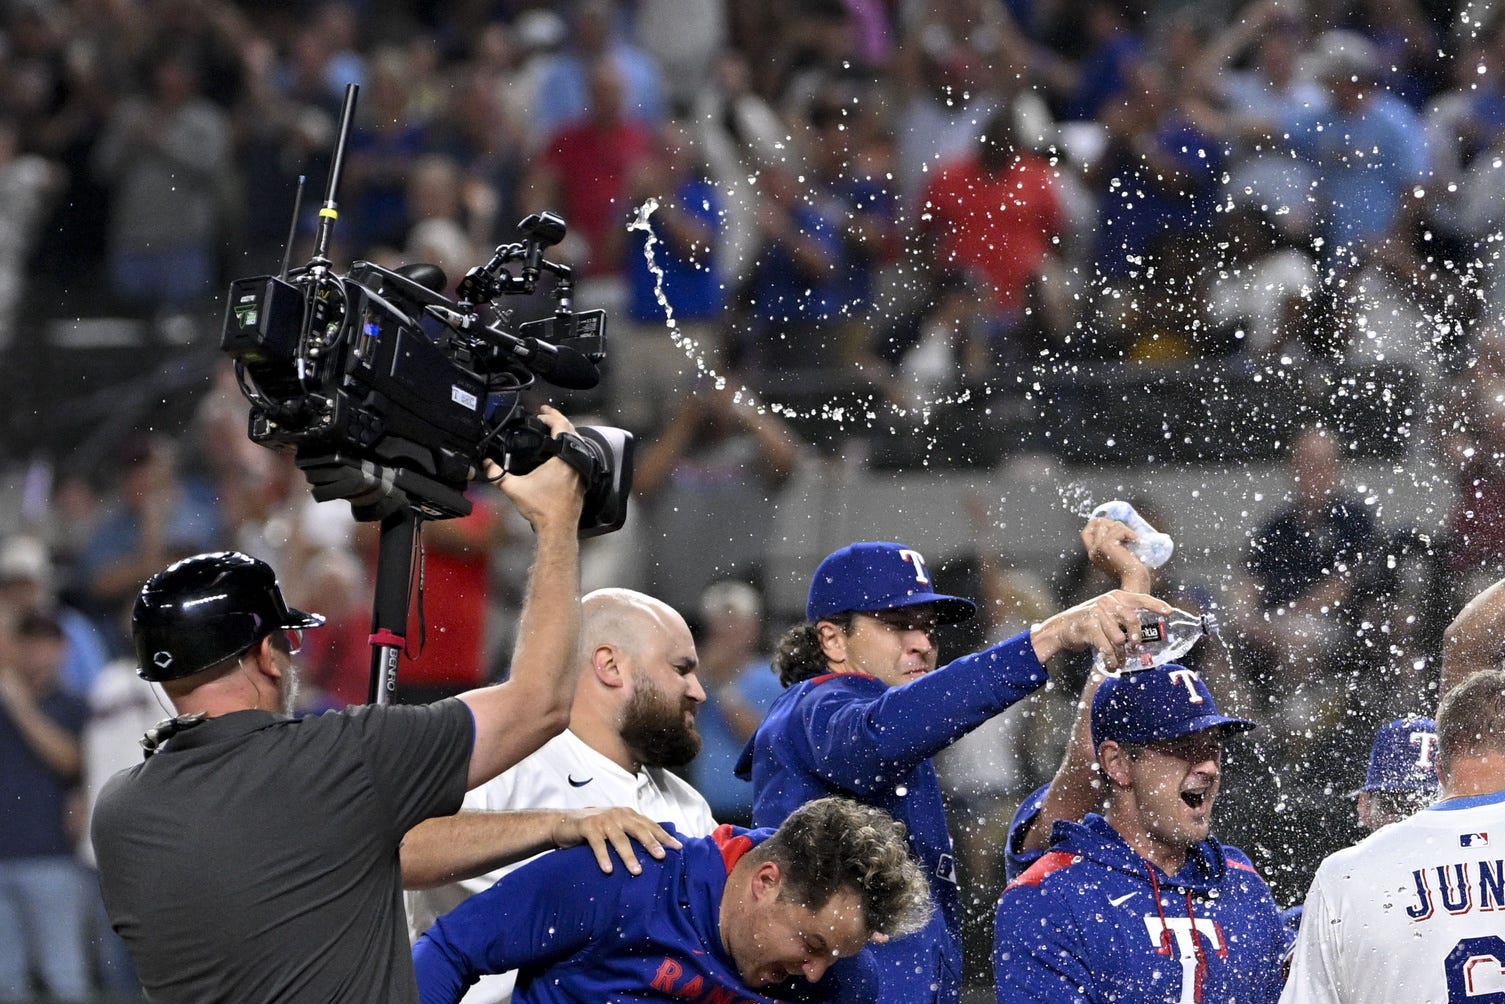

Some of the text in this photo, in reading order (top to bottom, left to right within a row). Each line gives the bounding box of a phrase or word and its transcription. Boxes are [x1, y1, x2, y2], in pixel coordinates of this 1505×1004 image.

[899, 549, 929, 586] T
[386, 648, 399, 692] BENRO
[1168, 669, 1204, 705] T
